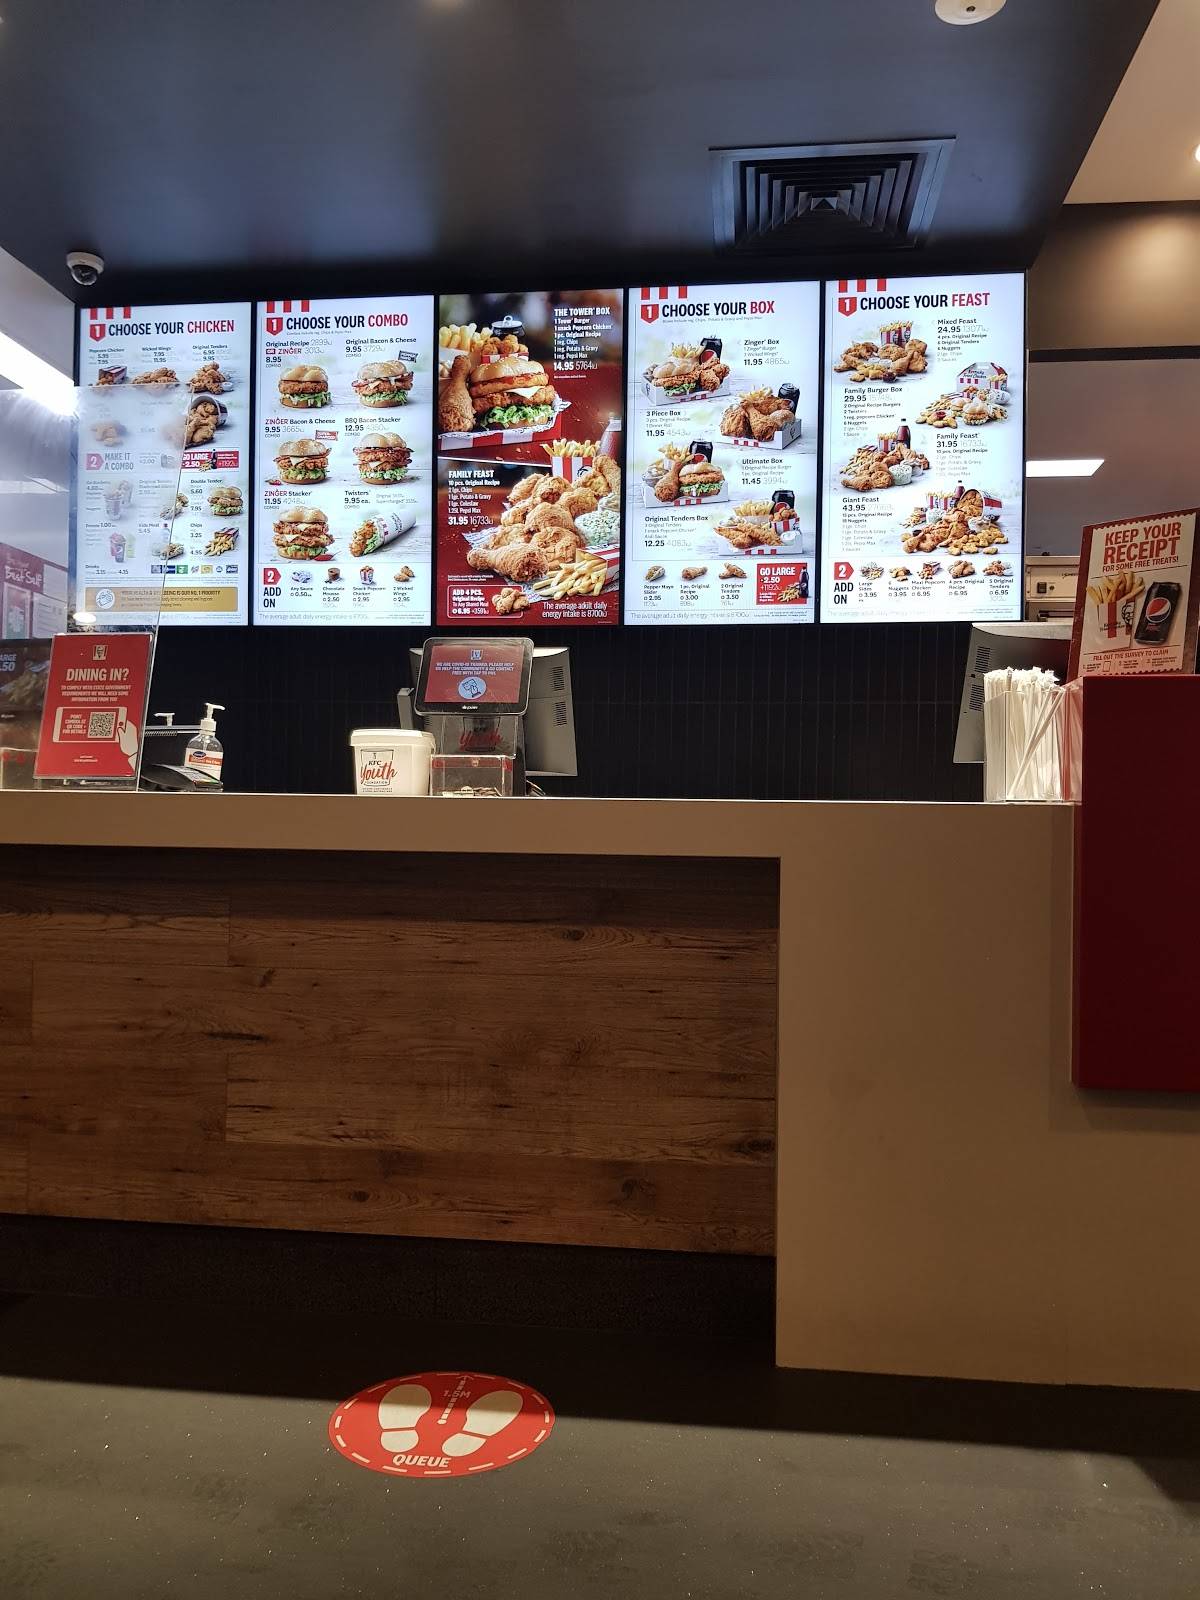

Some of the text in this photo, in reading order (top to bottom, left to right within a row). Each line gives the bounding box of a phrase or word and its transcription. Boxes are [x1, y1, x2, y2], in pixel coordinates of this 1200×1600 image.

[844, 293, 990, 312] 1 CHOOSE YOUR FEAST
[596, 307, 610, 315] BOX
[647, 301, 775, 318] 1 CHOOSE YOUR BOX
[286, 317, 331, 330] CHOOSE
[334, 315, 365, 328] YOUR
[368, 314, 408, 327] COMBO
[94, 320, 234, 338] 1 CHOOSE YOUR CHICKEN
[554, 362, 574, 371] 14.95
[844, 387, 866, 395] Family
[265, 417, 289, 425] ZINGER
[90, 452, 130, 468] 2 MAKE IT
[191, 452, 208, 460] LARGE
[111, 462, 134, 470] COMBO
[449, 470, 494, 478] FAMILY FEAST
[448, 516, 468, 525] 31.95
[1105, 522, 1182, 546] KEEP YOUR
[1104, 537, 1180, 564] RECEIPT
[1103, 556, 1179, 572] FOR SOME FREE TREATS!
[268, 571, 274, 582] 2
[760, 567, 796, 576] GO LARGE
[838, 565, 846, 578] 2
[263, 587, 281, 597] ADD
[834, 582, 854, 592] ADD
[263, 598, 276, 608] ON
[834, 594, 847, 604] ON
[543, 602, 554, 610] The
[594, 602, 607, 610] daily
[542, 611, 562, 619] energy
[66, 668, 129, 681] DINING IN?
[359, 761, 398, 784] Youth
[443, 1390, 471, 1398] 1.5M
[392, 1454, 451, 1468] QUEUE
